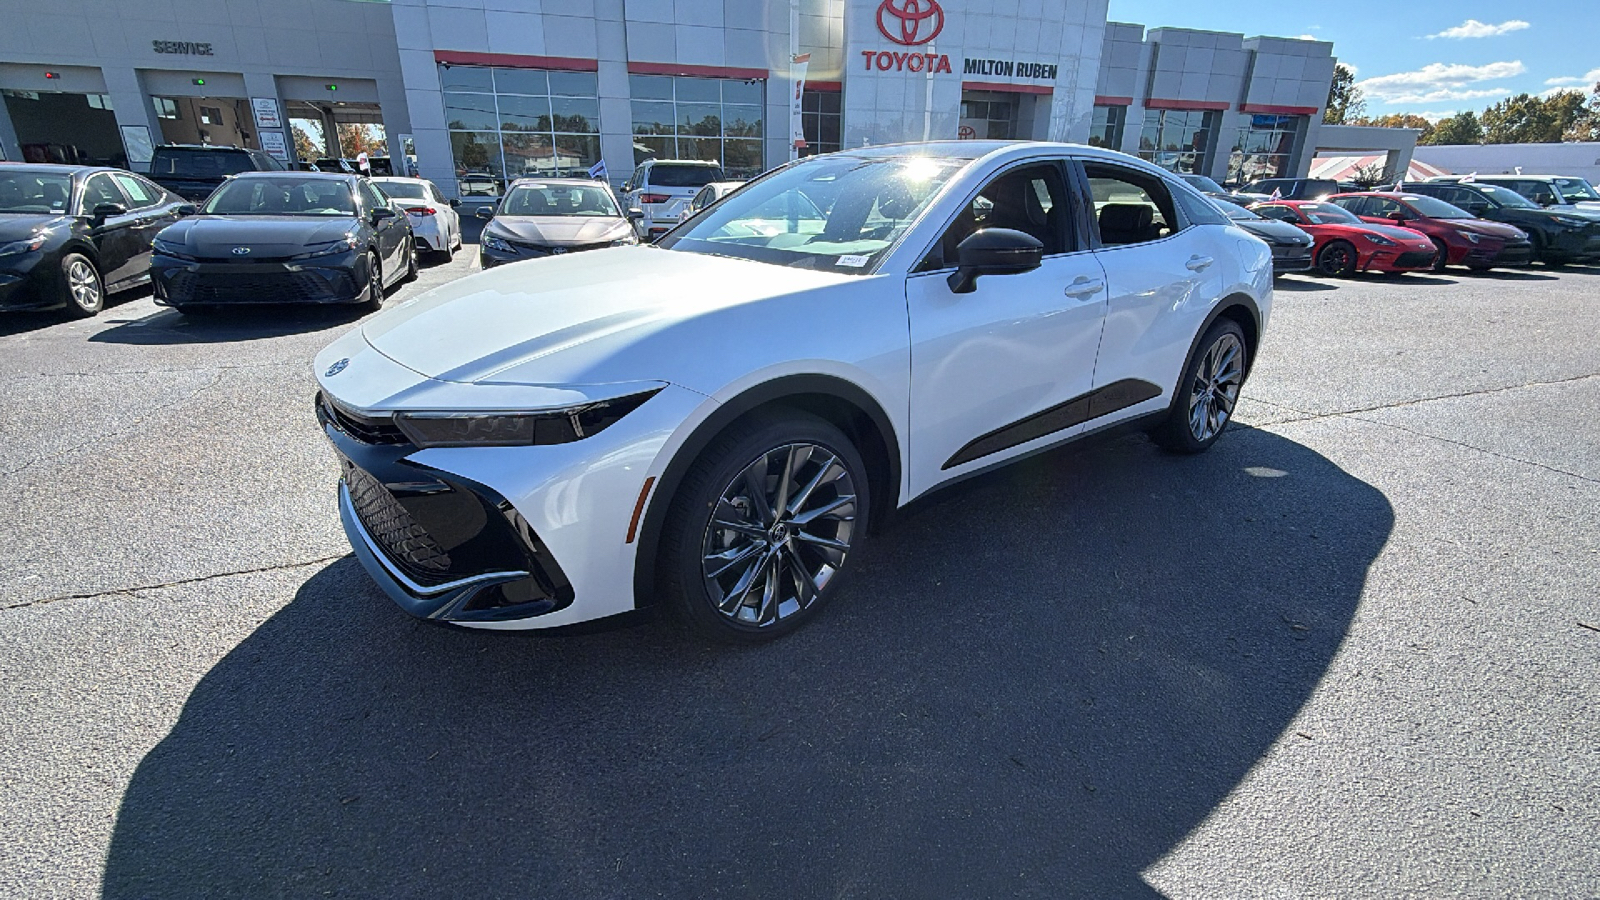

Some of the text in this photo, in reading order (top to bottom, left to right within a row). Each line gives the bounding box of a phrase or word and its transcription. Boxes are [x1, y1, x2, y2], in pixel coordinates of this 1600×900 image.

[152, 40, 214, 55] SERVICE
[861, 50, 952, 74] TOYOTA
[963, 58, 1057, 80] MILTON RUBEN
